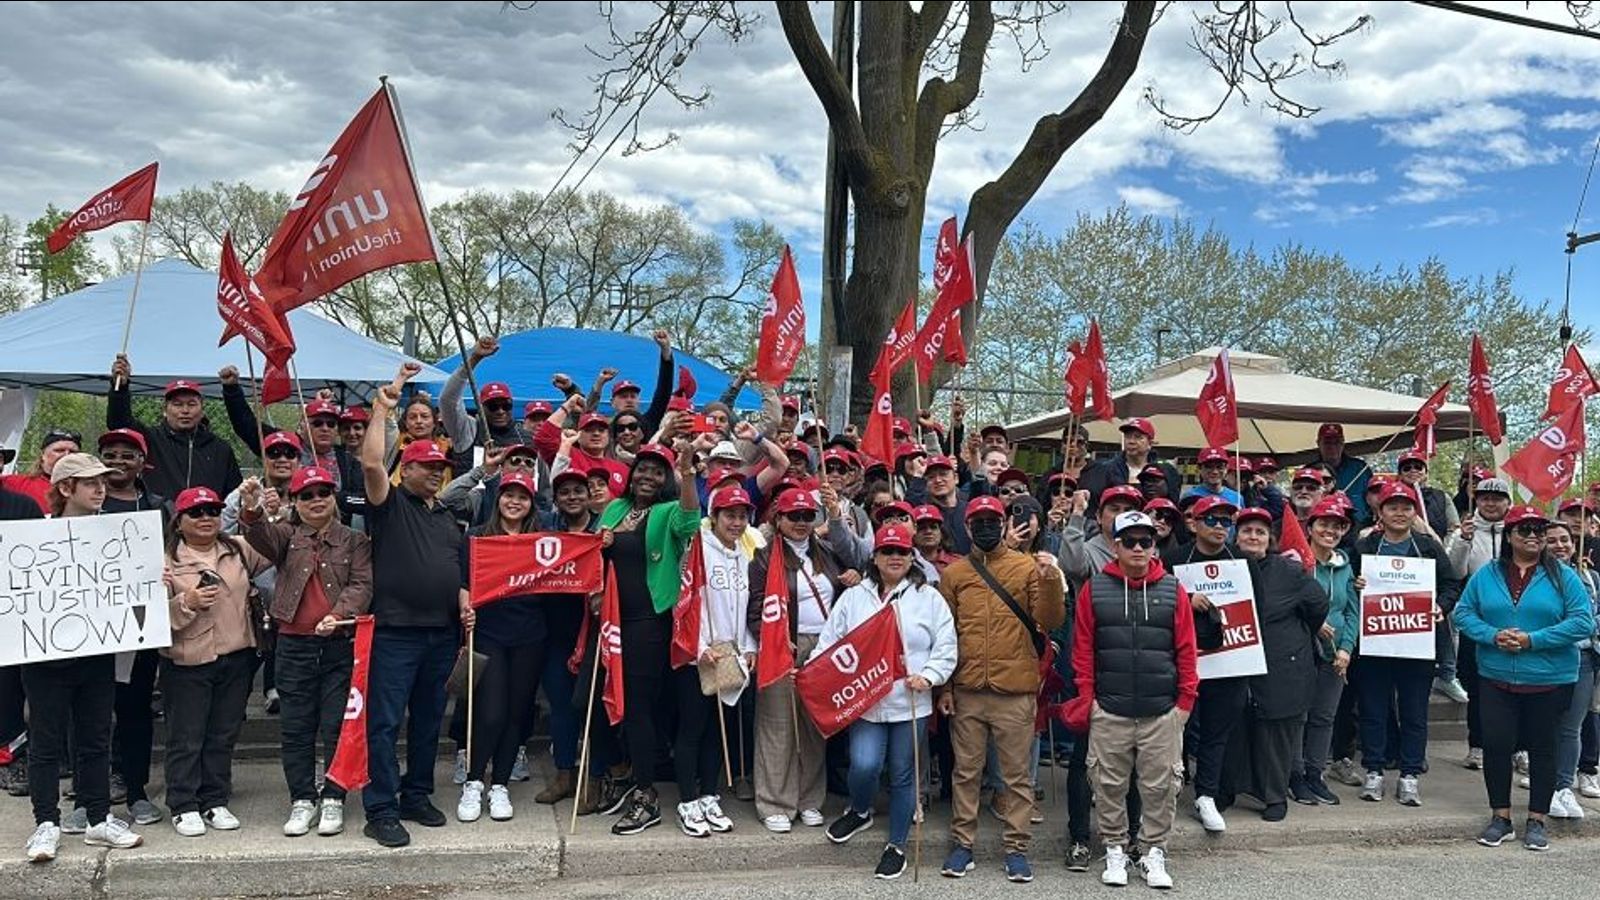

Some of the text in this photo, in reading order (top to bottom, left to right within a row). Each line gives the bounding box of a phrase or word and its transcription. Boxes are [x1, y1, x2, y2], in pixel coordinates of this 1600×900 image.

[9, 561, 122, 590] LIVING
[1380, 595, 1404, 612] ON
[22, 605, 146, 658] NOW!
[1367, 612, 1429, 632] STRIKE
